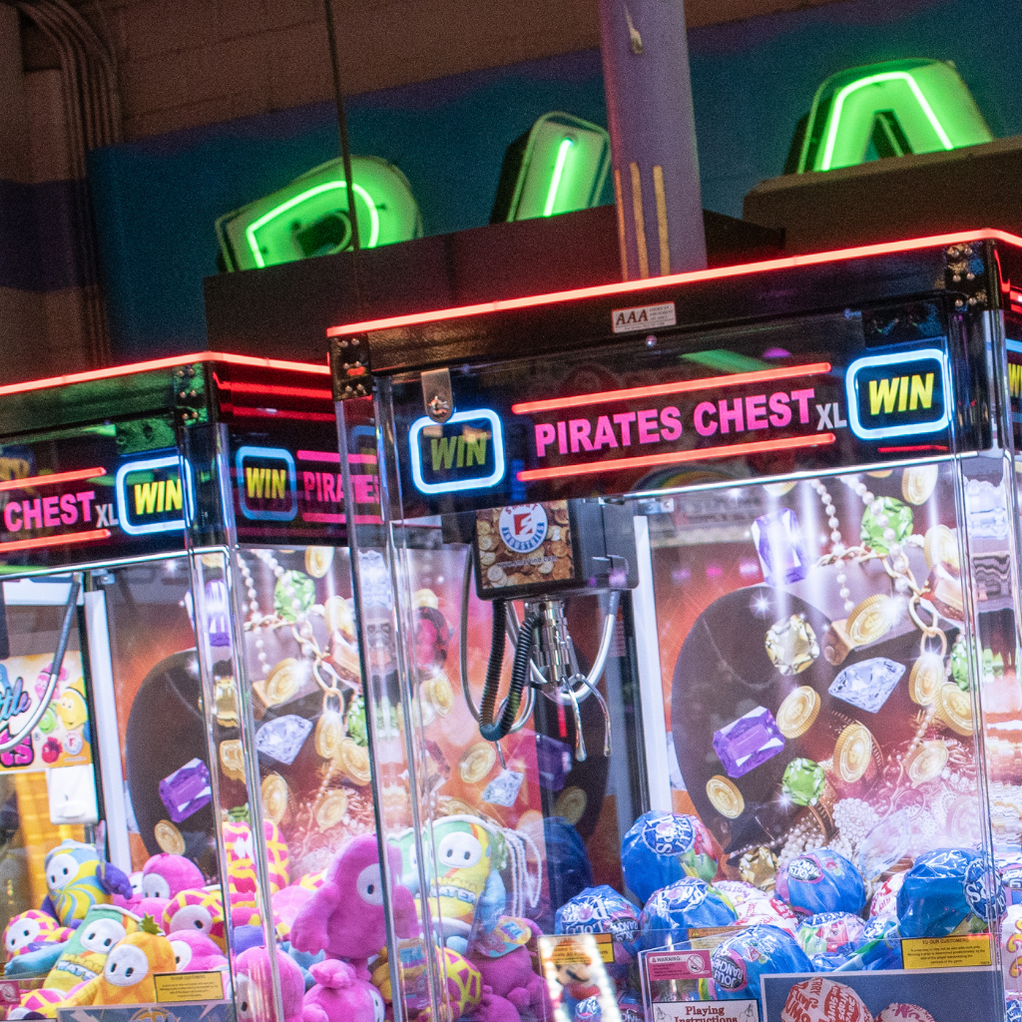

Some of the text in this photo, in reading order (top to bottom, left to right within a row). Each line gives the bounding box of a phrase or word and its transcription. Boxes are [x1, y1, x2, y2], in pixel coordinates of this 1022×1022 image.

[616, 309, 648, 325] AAA
[868, 373, 935, 416] WIN
[535, 388, 848, 457] PIRATES CHEST XL
[431, 432, 487, 471] WIN
[134, 478, 184, 516] WIN
[246, 467, 287, 499] WIN
[3, 491, 120, 533] CHEST XL
[685, 1005, 725, 1016] Playing
